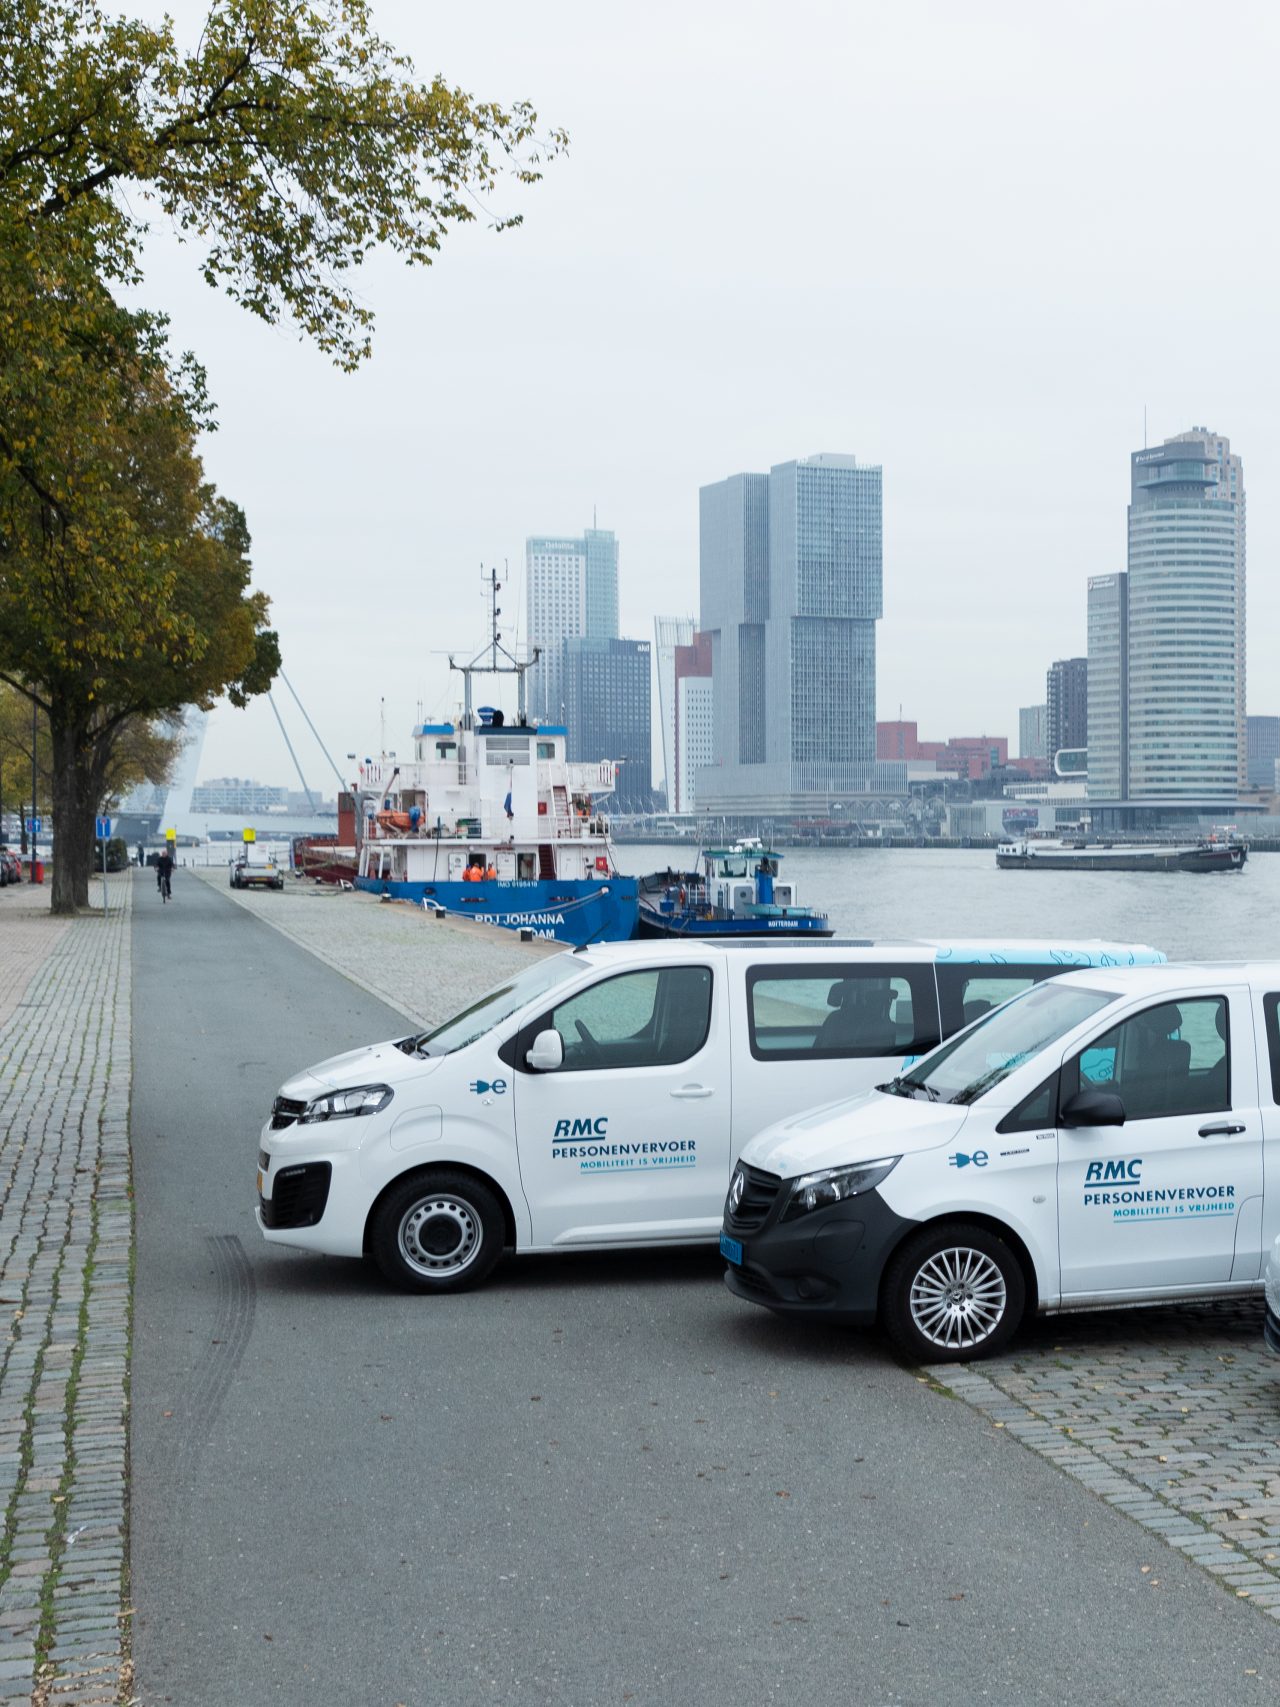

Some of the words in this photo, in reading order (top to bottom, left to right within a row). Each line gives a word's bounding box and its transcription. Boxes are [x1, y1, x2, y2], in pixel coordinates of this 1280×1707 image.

[503, 913, 565, 925] JOHANNA
[554, 1117, 608, 1137] RMC
[552, 1140, 696, 1159] PERSONENVERVOER
[580, 1159, 634, 1169] MOBILITEIT
[652, 1155, 696, 1164] VRIJHEID
[1085, 1159, 1142, 1181] RMC
[1084, 1185, 1235, 1206] PERSONENVERVOER
[1113, 1206, 1170, 1217] MOBILITEIT
[1175, 1205, 1184, 1213] IS
[1189, 1202, 1235, 1212] VRIJHEID
